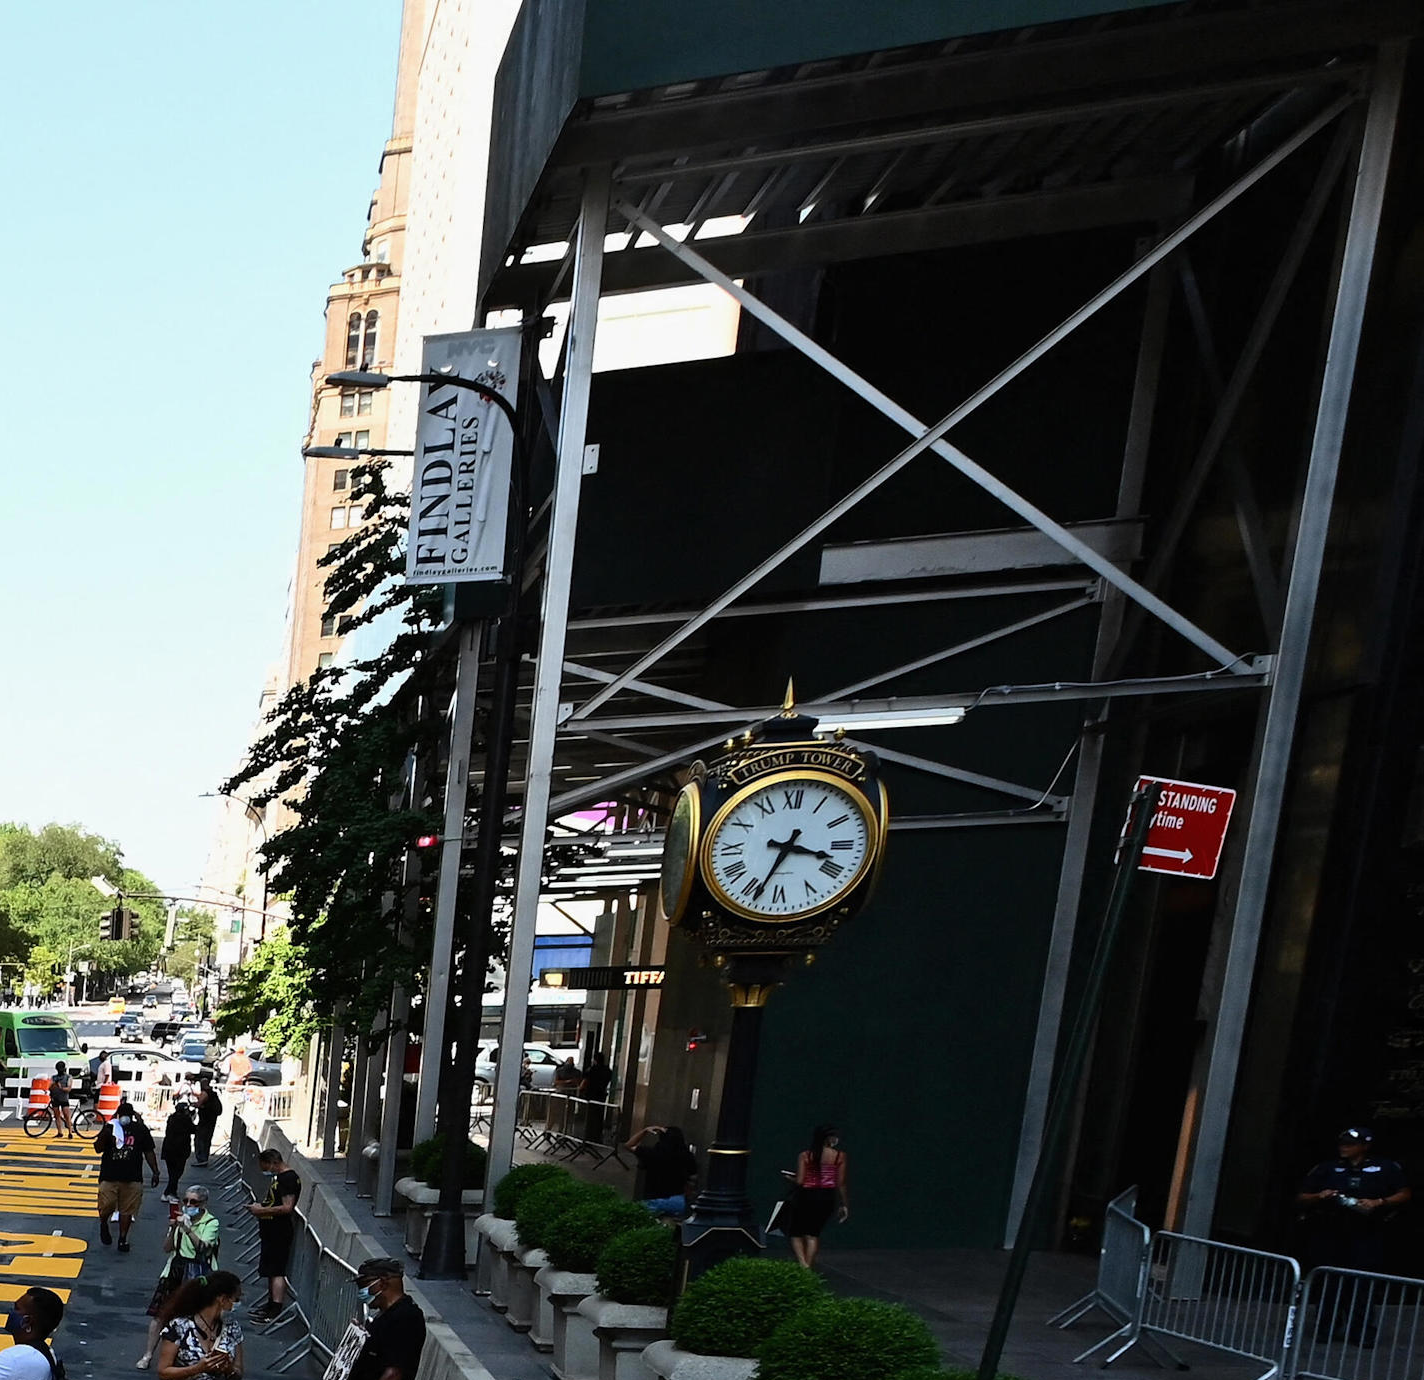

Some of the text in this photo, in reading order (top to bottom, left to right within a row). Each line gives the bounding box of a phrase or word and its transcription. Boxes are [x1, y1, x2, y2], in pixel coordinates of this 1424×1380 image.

[415, 366, 460, 567] FINDLAY
[451, 416, 479, 565] GALLERIES
[739, 751, 853, 779] TRUMP TOWER
[1157, 790, 1217, 814] STANDING
